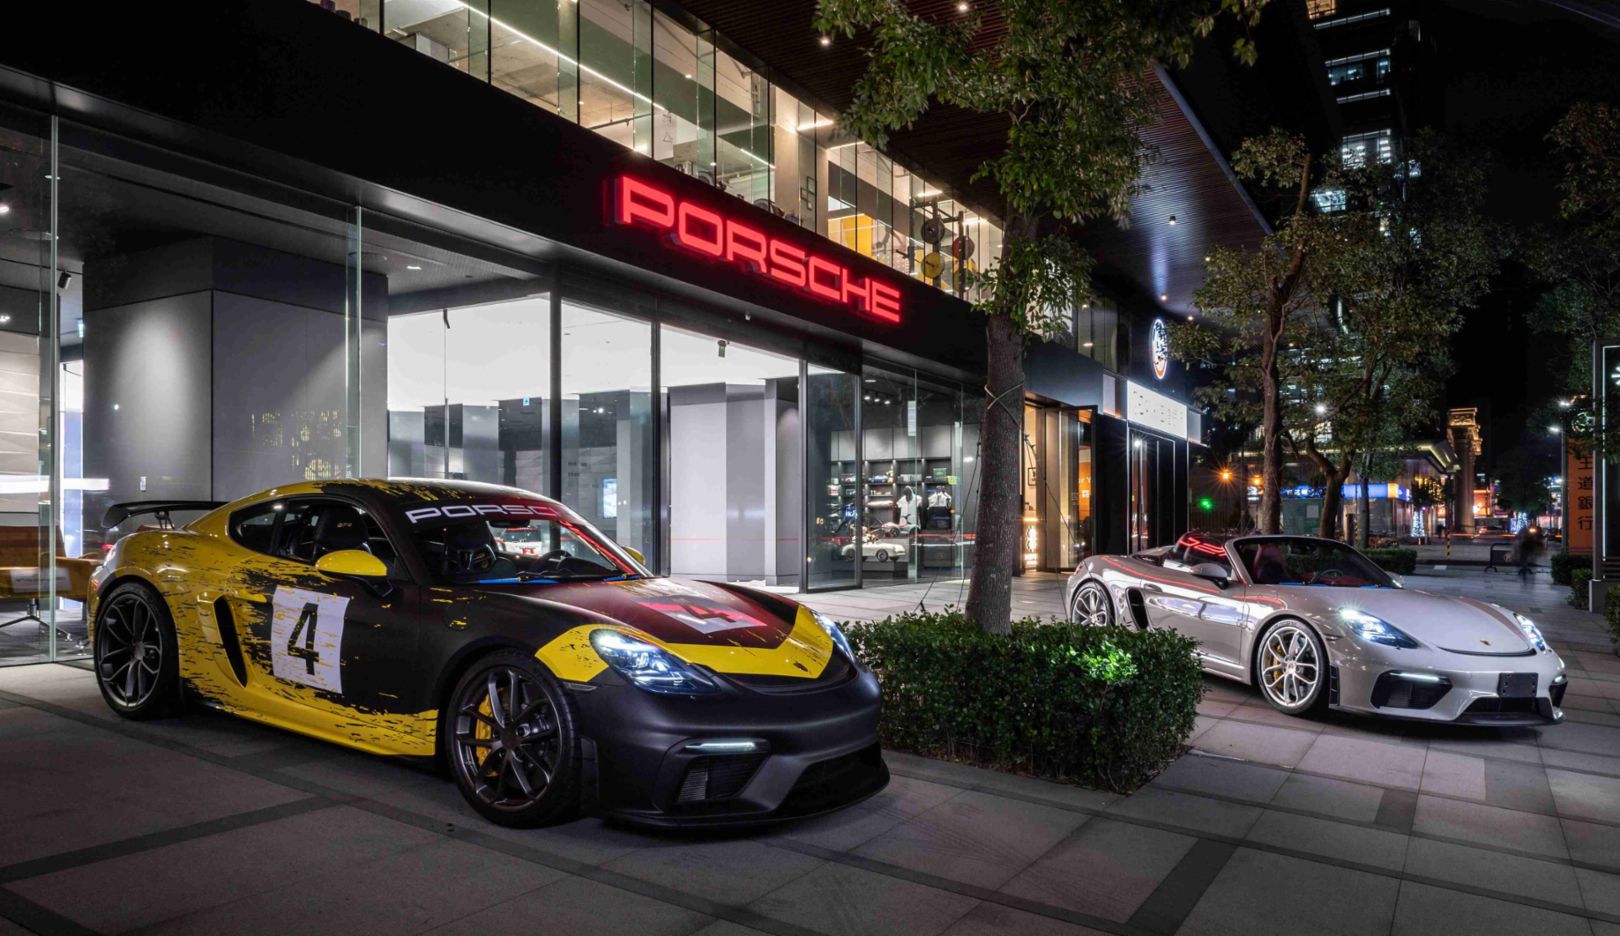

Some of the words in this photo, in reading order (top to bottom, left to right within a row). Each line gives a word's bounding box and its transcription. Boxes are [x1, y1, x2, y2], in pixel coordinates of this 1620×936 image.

[622, 175, 901, 324] PORSCHE
[405, 504, 560, 524] PORSC
[287, 602, 320, 676] 4
